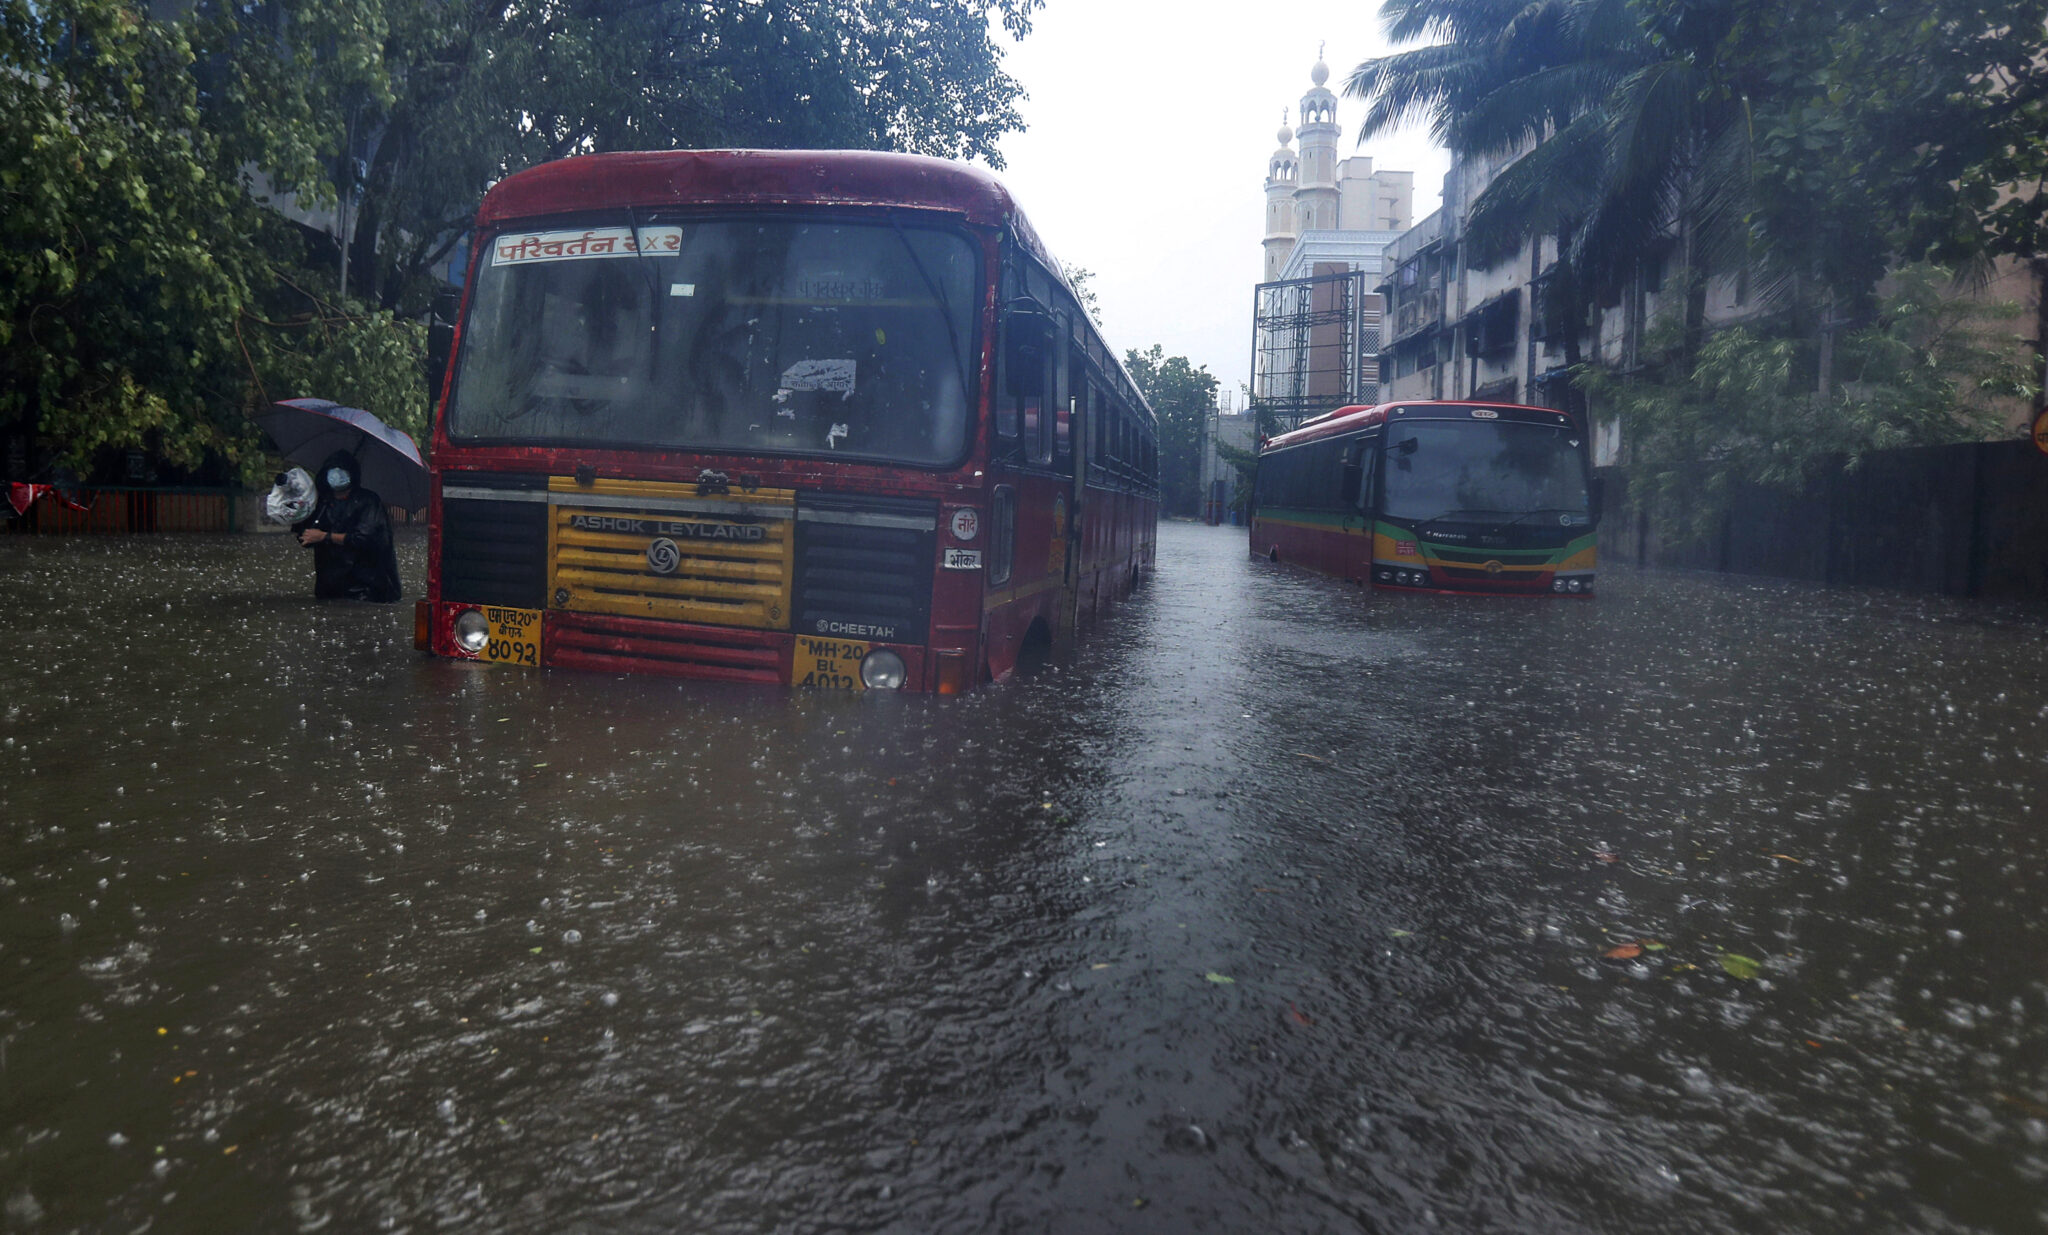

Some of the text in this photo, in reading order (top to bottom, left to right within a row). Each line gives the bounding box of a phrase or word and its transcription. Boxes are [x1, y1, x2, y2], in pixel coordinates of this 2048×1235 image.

[499, 232, 619, 260] परिवर्तन
[573, 515, 762, 540] ASHOK LEYLAND
[829, 621, 895, 638] CHEETAH
